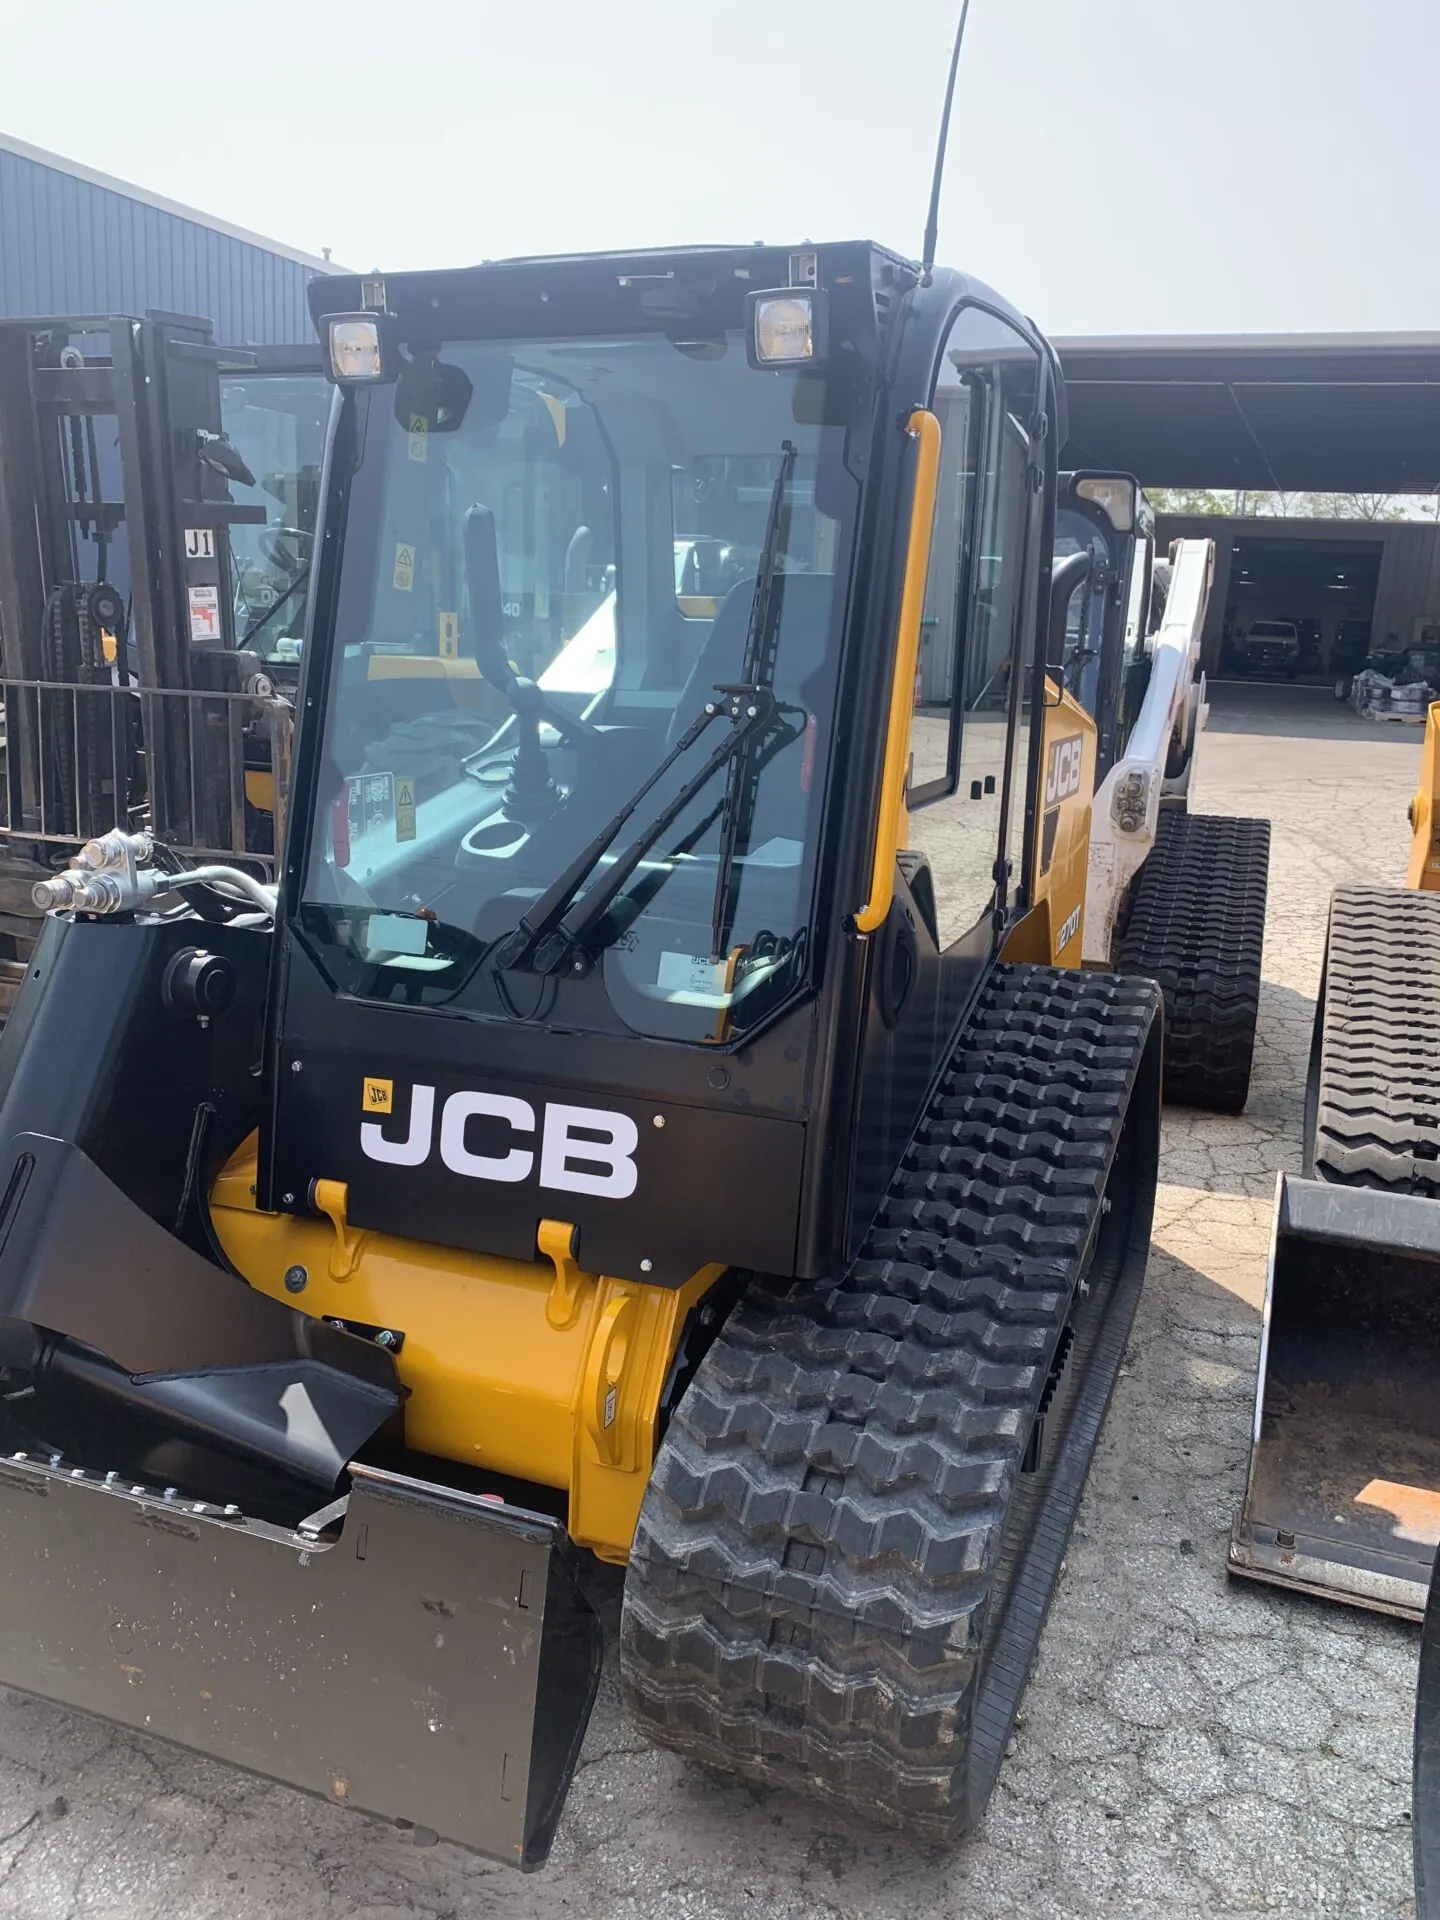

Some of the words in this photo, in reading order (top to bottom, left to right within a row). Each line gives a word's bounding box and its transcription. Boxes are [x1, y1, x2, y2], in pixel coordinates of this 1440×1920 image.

[188, 531, 211, 556] J1
[1046, 739, 1082, 802] JCB
[1057, 903, 1082, 952] 270T
[371, 1087, 389, 1103] JCB
[360, 1083, 639, 1200] JCB
